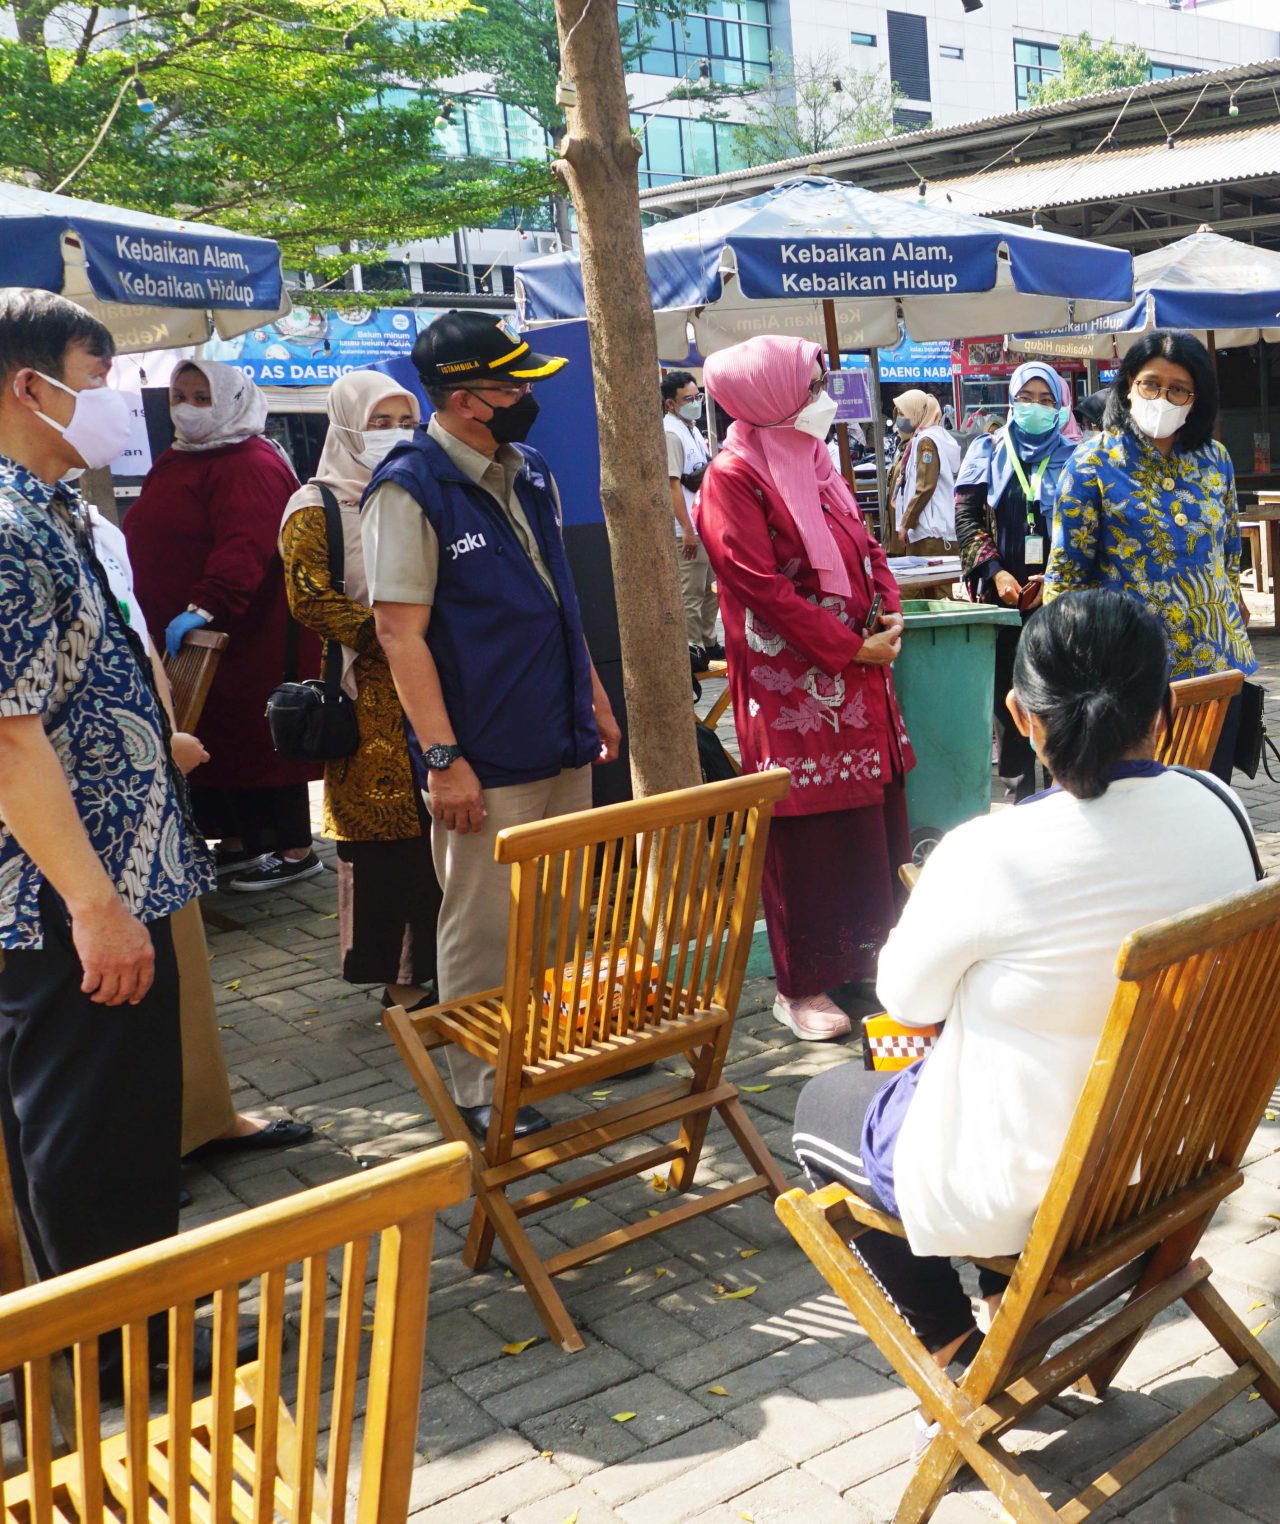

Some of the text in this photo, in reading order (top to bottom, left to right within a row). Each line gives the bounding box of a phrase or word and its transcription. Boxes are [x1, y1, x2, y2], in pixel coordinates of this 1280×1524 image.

[115, 235, 250, 274] Kebaikan Alam,
[780, 242, 954, 264] Kebaikan Alam,
[118, 272, 255, 307] Kebaikan Hidup
[782, 270, 957, 292] Kebaikan Hidup
[1091, 317, 1124, 331] Hidup
[260, 366, 284, 379] AS
[291, 365, 354, 379] DAENG
[880, 366, 953, 378] DAENG NABA
[450, 532, 487, 560] jaki
